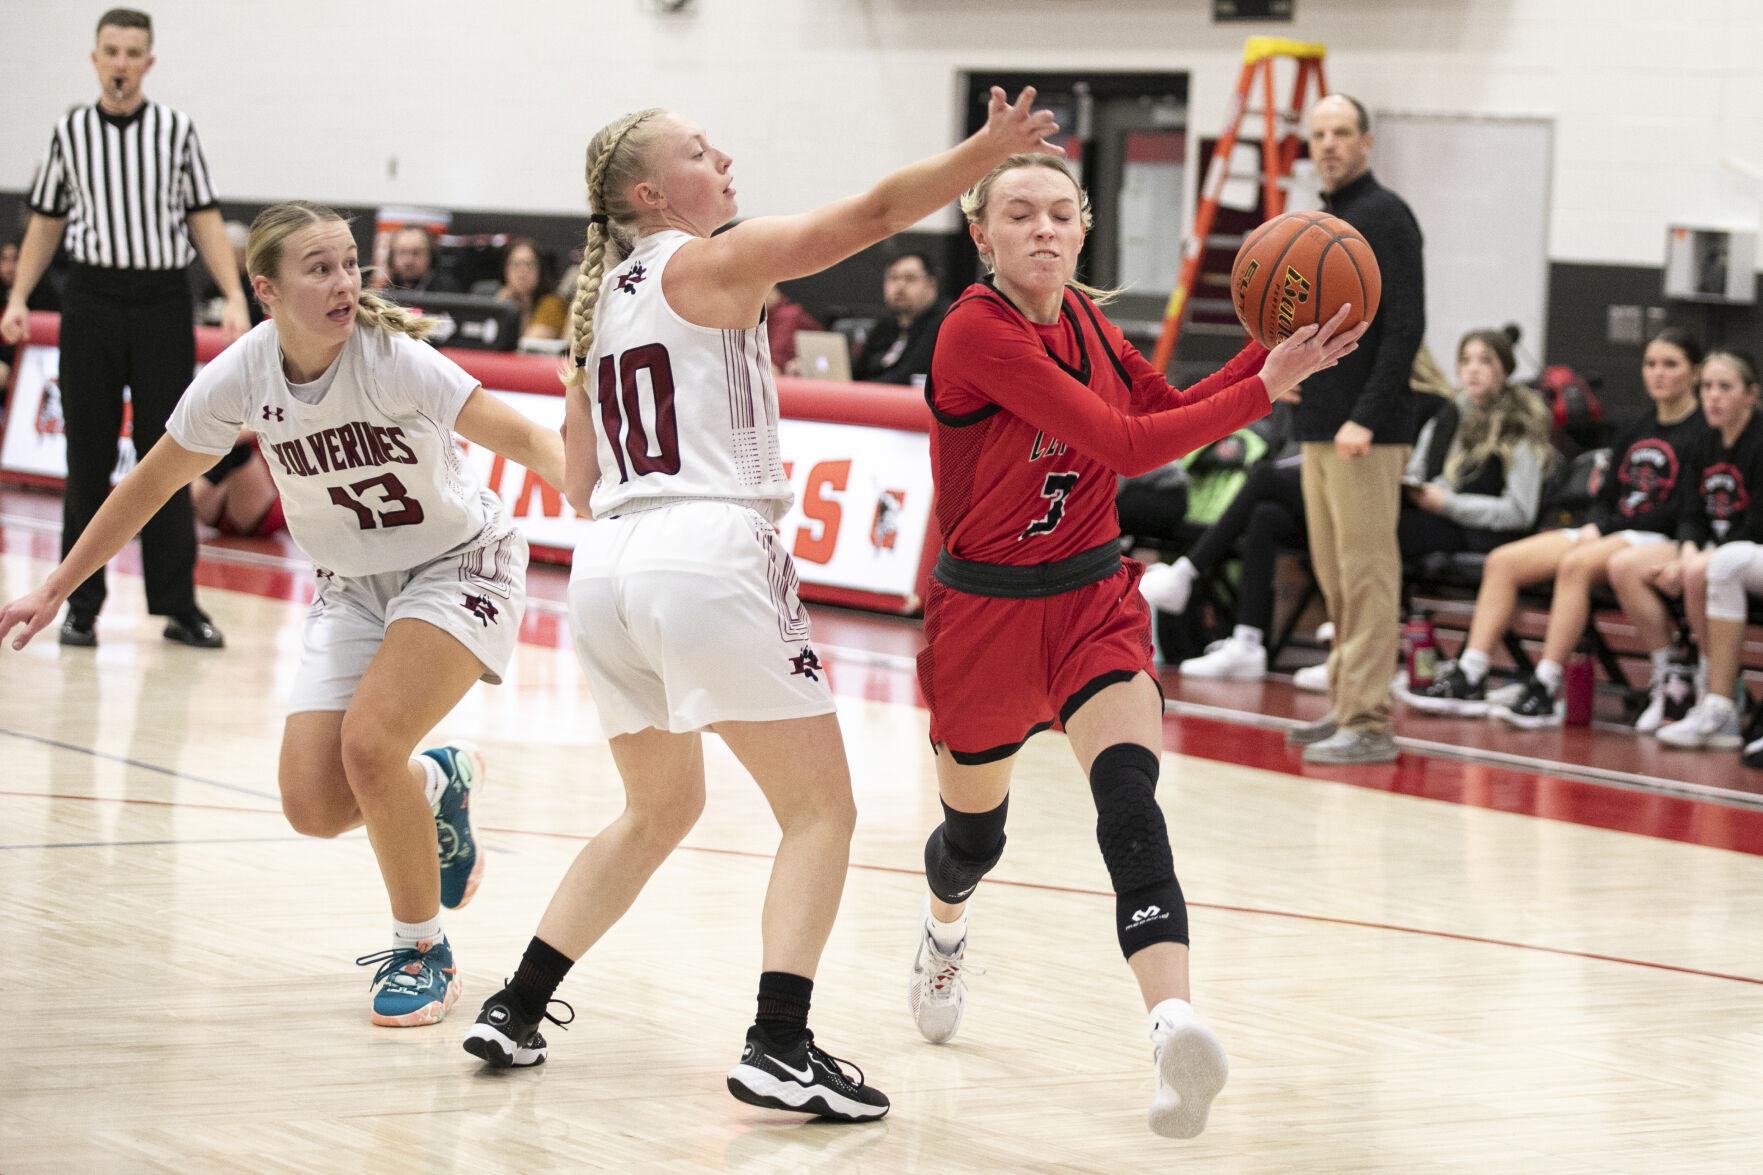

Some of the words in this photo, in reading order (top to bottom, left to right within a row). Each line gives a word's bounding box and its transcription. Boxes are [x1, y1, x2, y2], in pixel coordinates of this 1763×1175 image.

[1276, 265, 1312, 344] Bade
[598, 342, 682, 485] 10
[326, 472, 425, 531] 13
